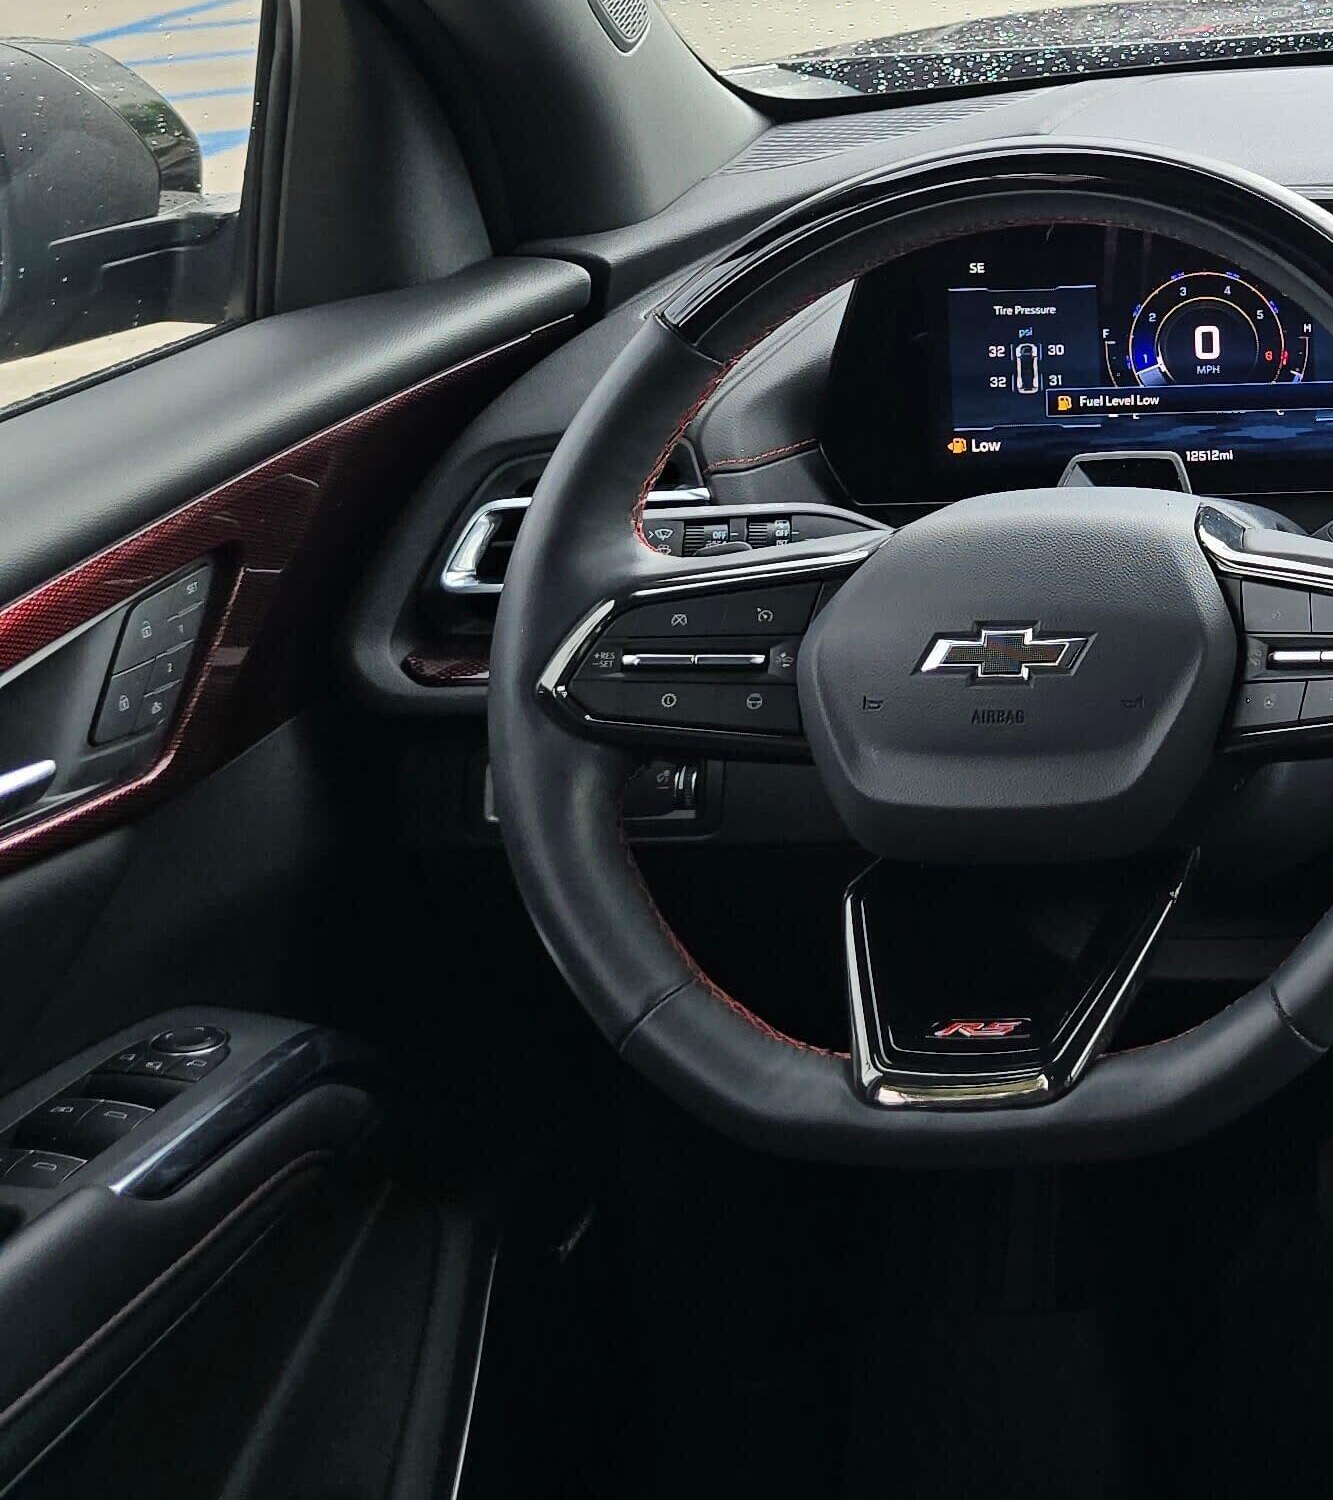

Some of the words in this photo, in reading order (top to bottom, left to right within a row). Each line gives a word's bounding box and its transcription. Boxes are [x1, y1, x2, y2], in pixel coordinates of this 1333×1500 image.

[969, 263, 985, 274] SE
[1180, 287, 1187, 296] 3
[1224, 286, 1231, 296] 4
[993, 305, 1013, 316] Tire
[1014, 305, 1057, 315] Pressure
[1257, 310, 1264, 320] 5
[1149, 313, 1157, 322] 2
[1018, 327, 1033, 338] psi
[1102, 329, 1110, 339] F
[1303, 324, 1311, 333] H
[1194, 325, 1220, 360] 0
[988, 345, 1006, 357] 32
[1047, 344, 1065, 356] 30
[1143, 354, 1148, 363] 1
[1265, 351, 1273, 361] 6
[1197, 365, 1220, 375] MPH
[990, 376, 1007, 388] 32
[1049, 375, 1063, 386] 31
[1079, 395, 1104, 407] Fuel
[1106, 395, 1135, 406] Level
[1136, 394, 1160, 406] Low
[972, 438, 1001, 453] Low
[1185, 449, 1233, 462] 12512mi
[713, 530, 727, 540] OFF
[775, 529, 789, 537] OFF
[185, 582, 198, 595] SET
[971, 708, 1025, 725] AIRBAG
[934, 1021, 1023, 1038] RS
